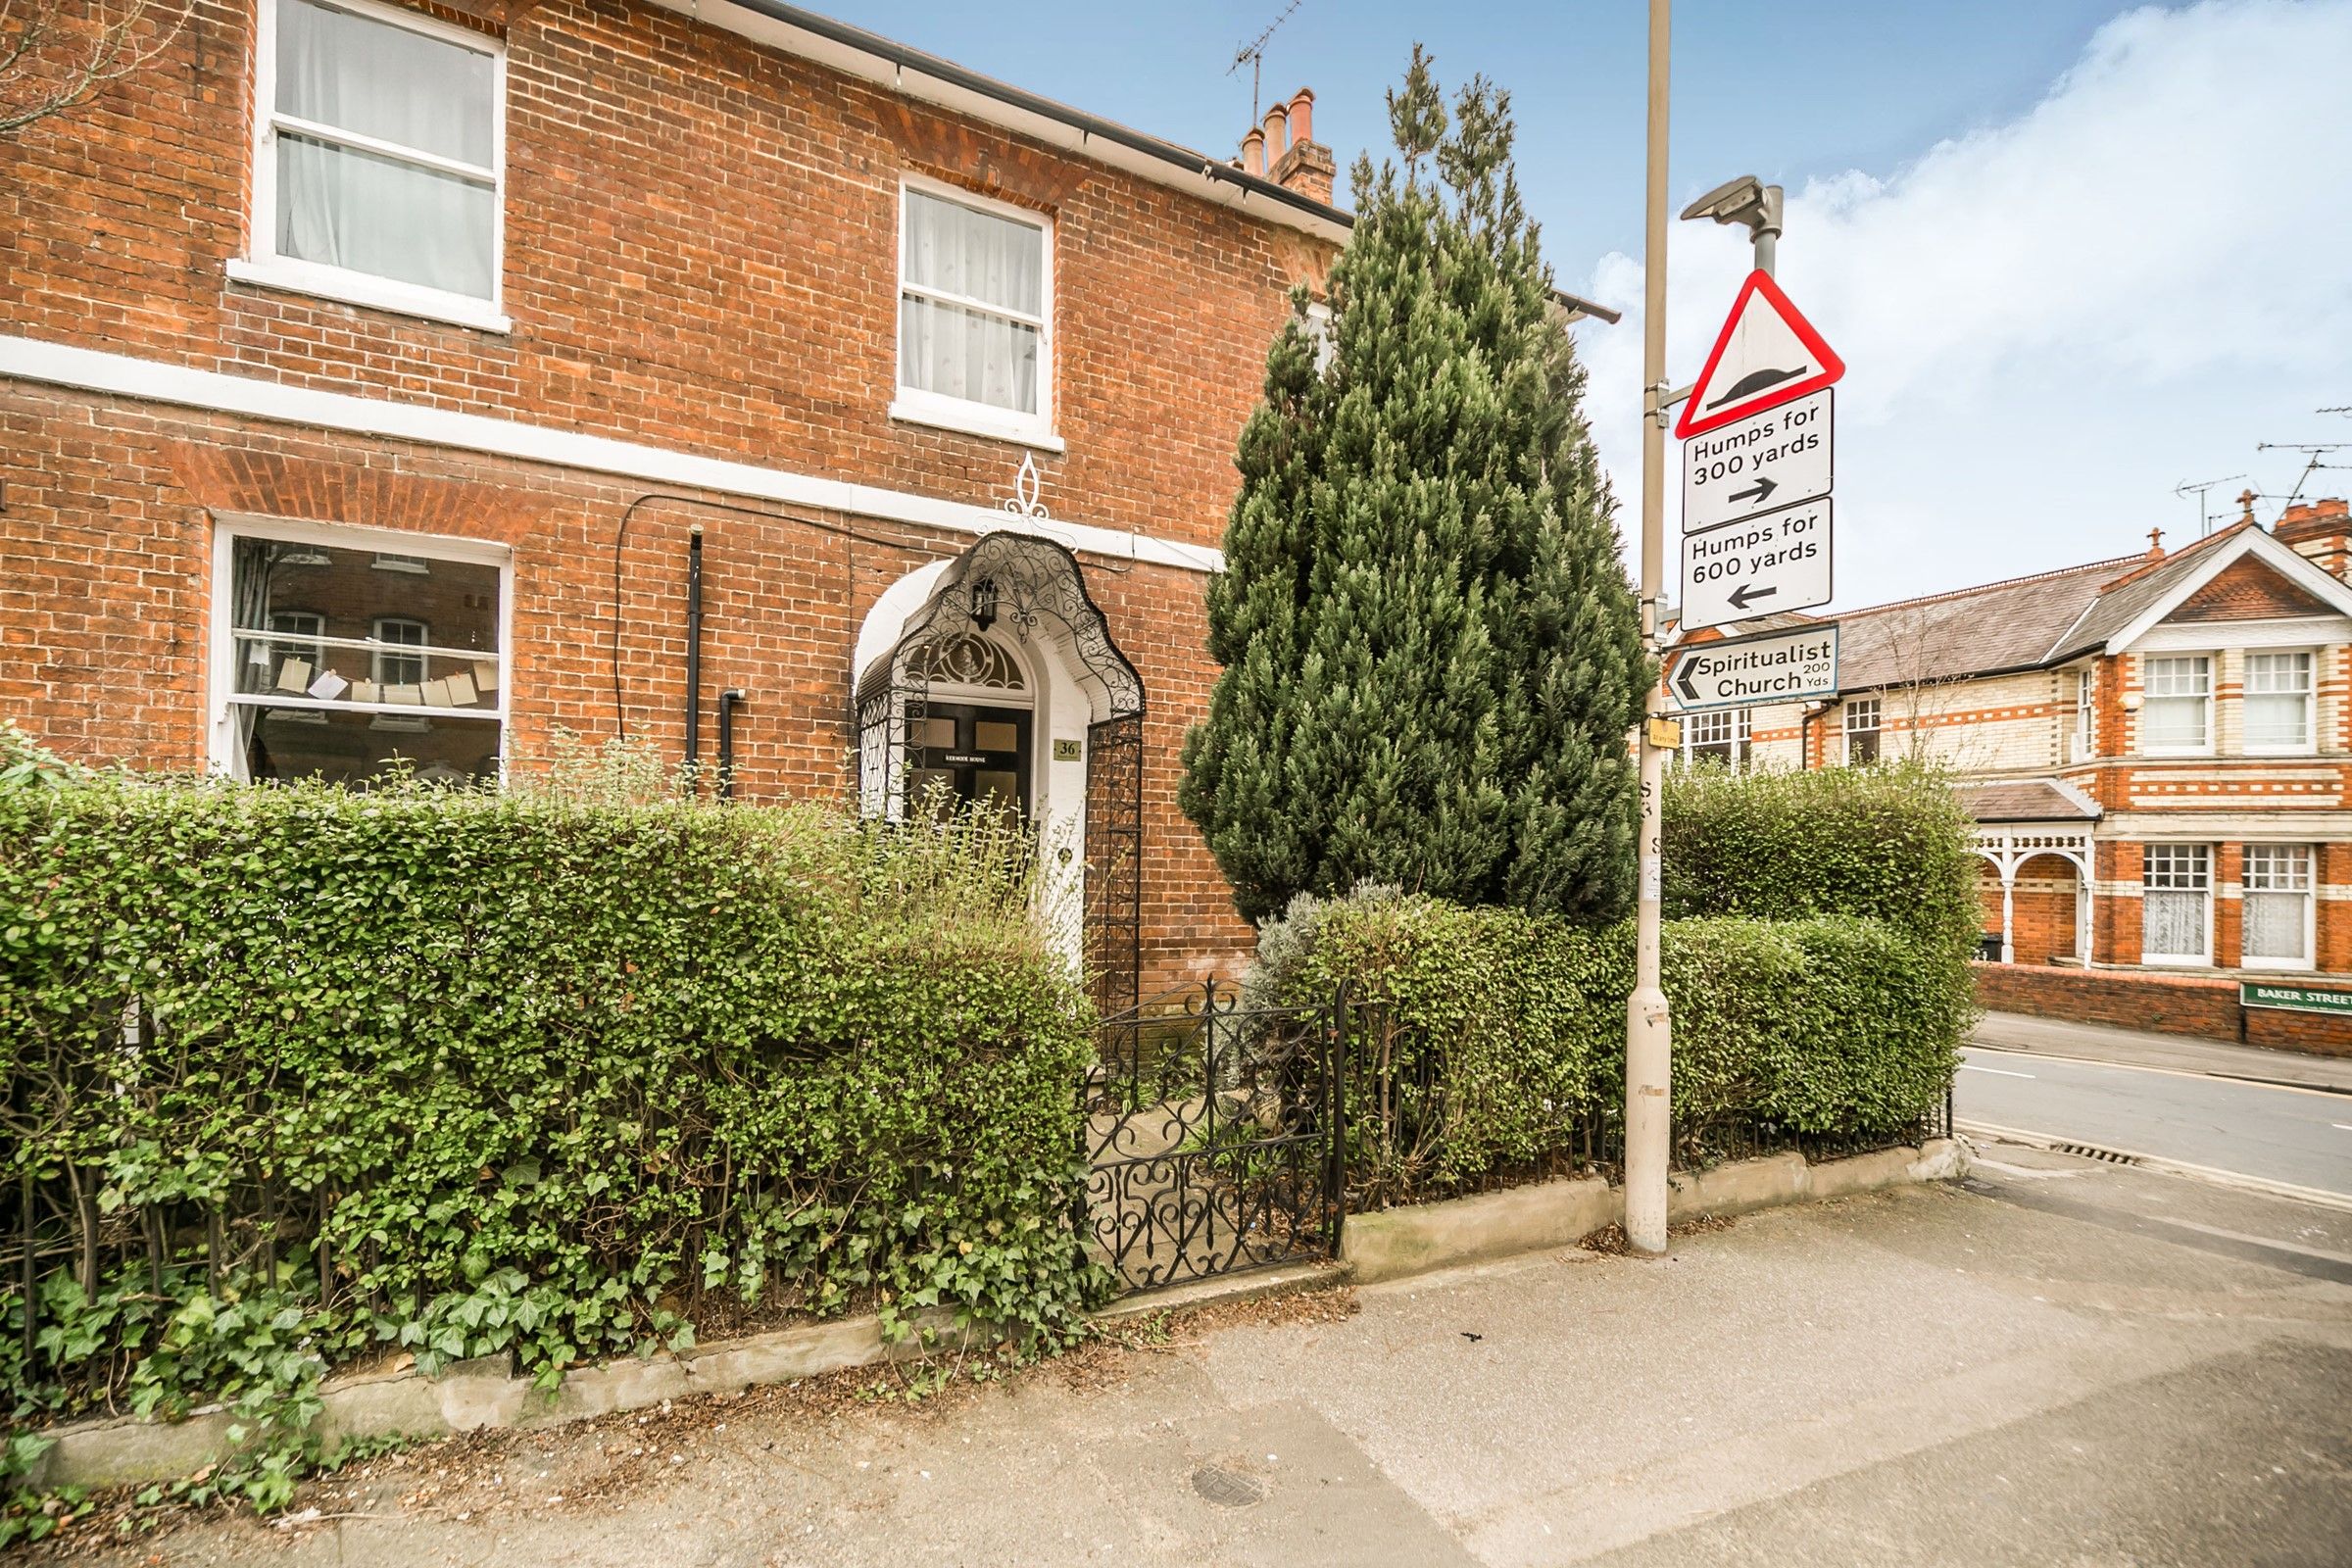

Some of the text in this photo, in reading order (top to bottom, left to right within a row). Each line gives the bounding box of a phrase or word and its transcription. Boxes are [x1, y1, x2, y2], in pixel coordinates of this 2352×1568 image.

[1694, 406, 1819, 462] Humps for
[1694, 433, 1819, 485] 300 yards
[1692, 514, 1818, 560] Humps for
[1693, 541, 1817, 583] 600 yards
[1697, 641, 1831, 676] Spiritualist
[1803, 662, 1831, 674] 200
[1717, 671, 1801, 697] Church
[1806, 677, 1829, 687] Yds
[1059, 742, 1075, 755] 36
[2257, 988, 2303, 1001] BAKER
